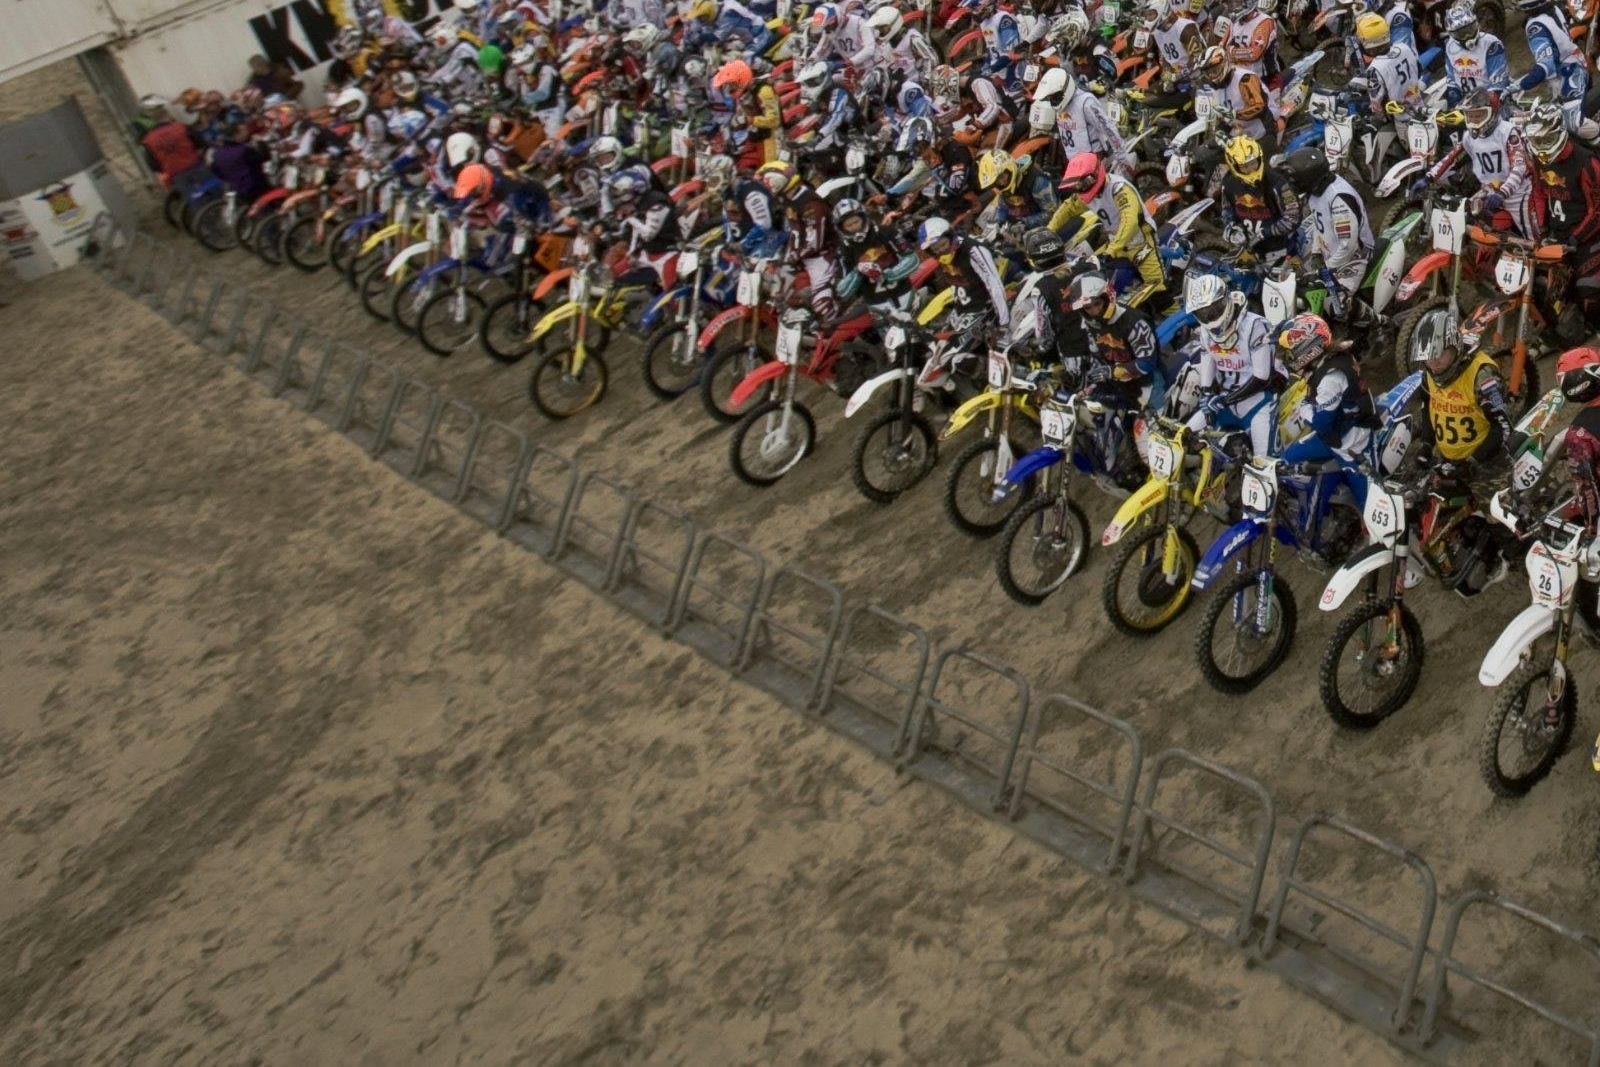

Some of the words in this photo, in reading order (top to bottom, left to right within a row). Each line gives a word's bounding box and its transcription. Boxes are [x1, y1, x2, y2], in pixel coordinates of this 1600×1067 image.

[1396, 58, 1411, 83] 57
[1414, 138, 1423, 149] 81
[1476, 150, 1502, 174] 107
[1438, 222, 1450, 235] 107
[1502, 272, 1512, 285] 44
[1269, 296, 1279, 308] 65
[1435, 413, 1477, 444] 653
[1519, 465, 1540, 487] 653
[1371, 508, 1389, 527] 653
[1539, 575, 1551, 591] 26
